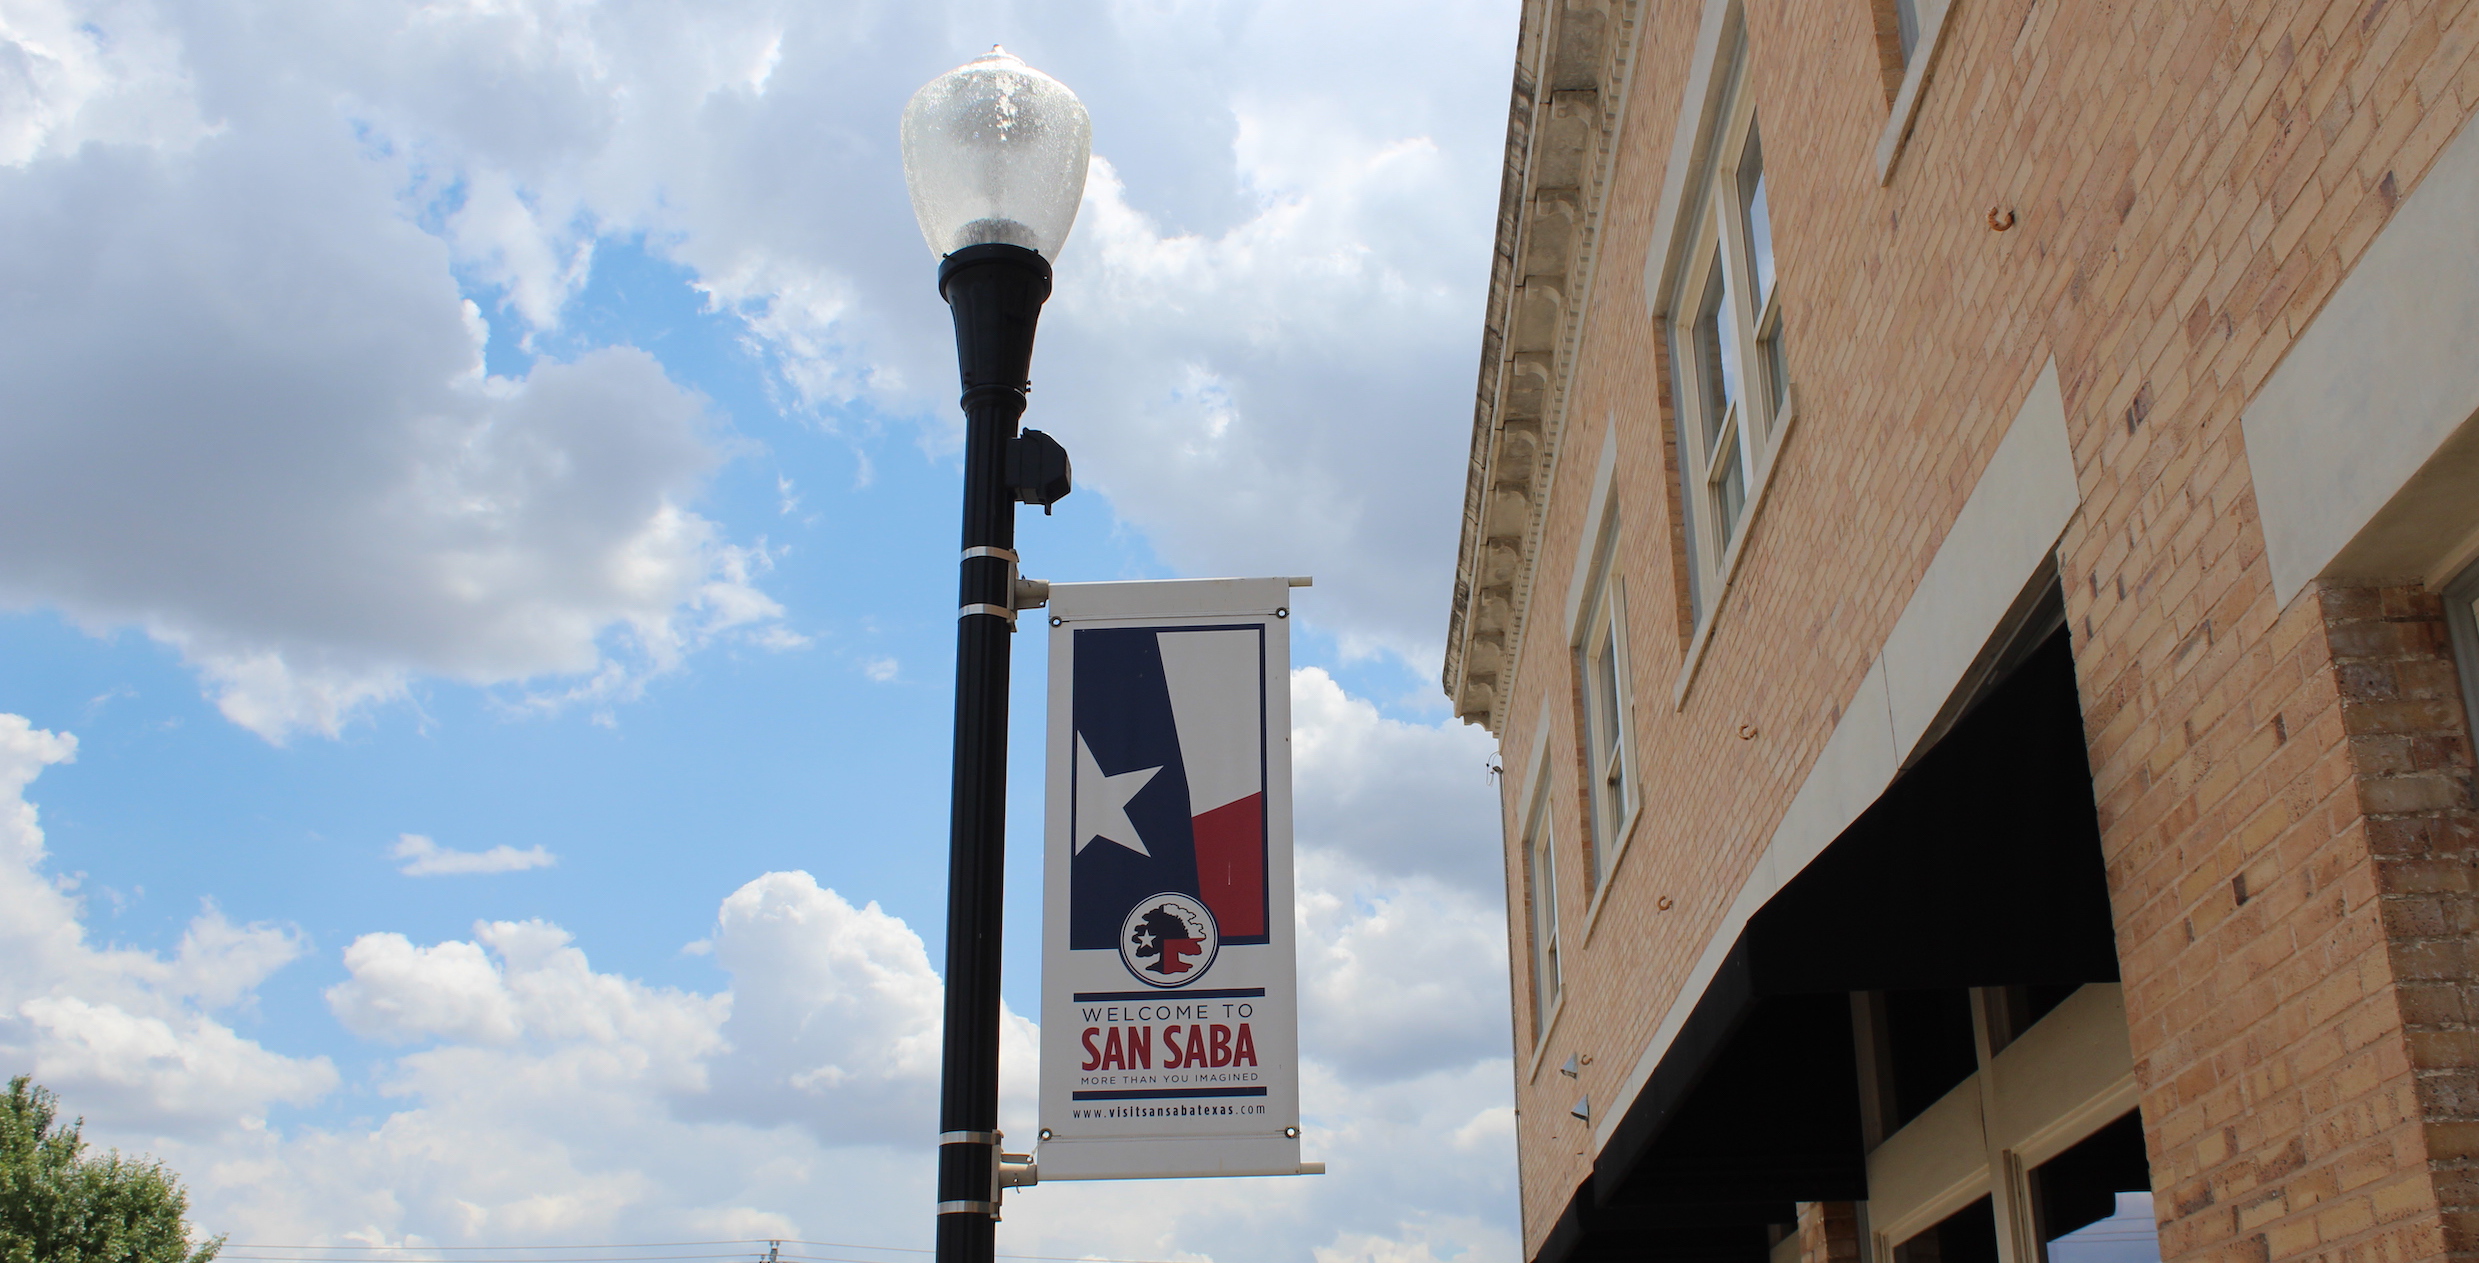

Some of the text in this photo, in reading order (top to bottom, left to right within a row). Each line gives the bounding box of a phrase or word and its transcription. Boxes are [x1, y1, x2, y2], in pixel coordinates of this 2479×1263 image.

[1082, 1003, 1253, 1022] WELCOME TO
[1081, 1023, 1258, 1071] SAN SABA
[1081, 1072, 1259, 1085] MORE THAN YOU IMAGINED
[1073, 1104, 1266, 1119] www.visitsansabatexas.com
